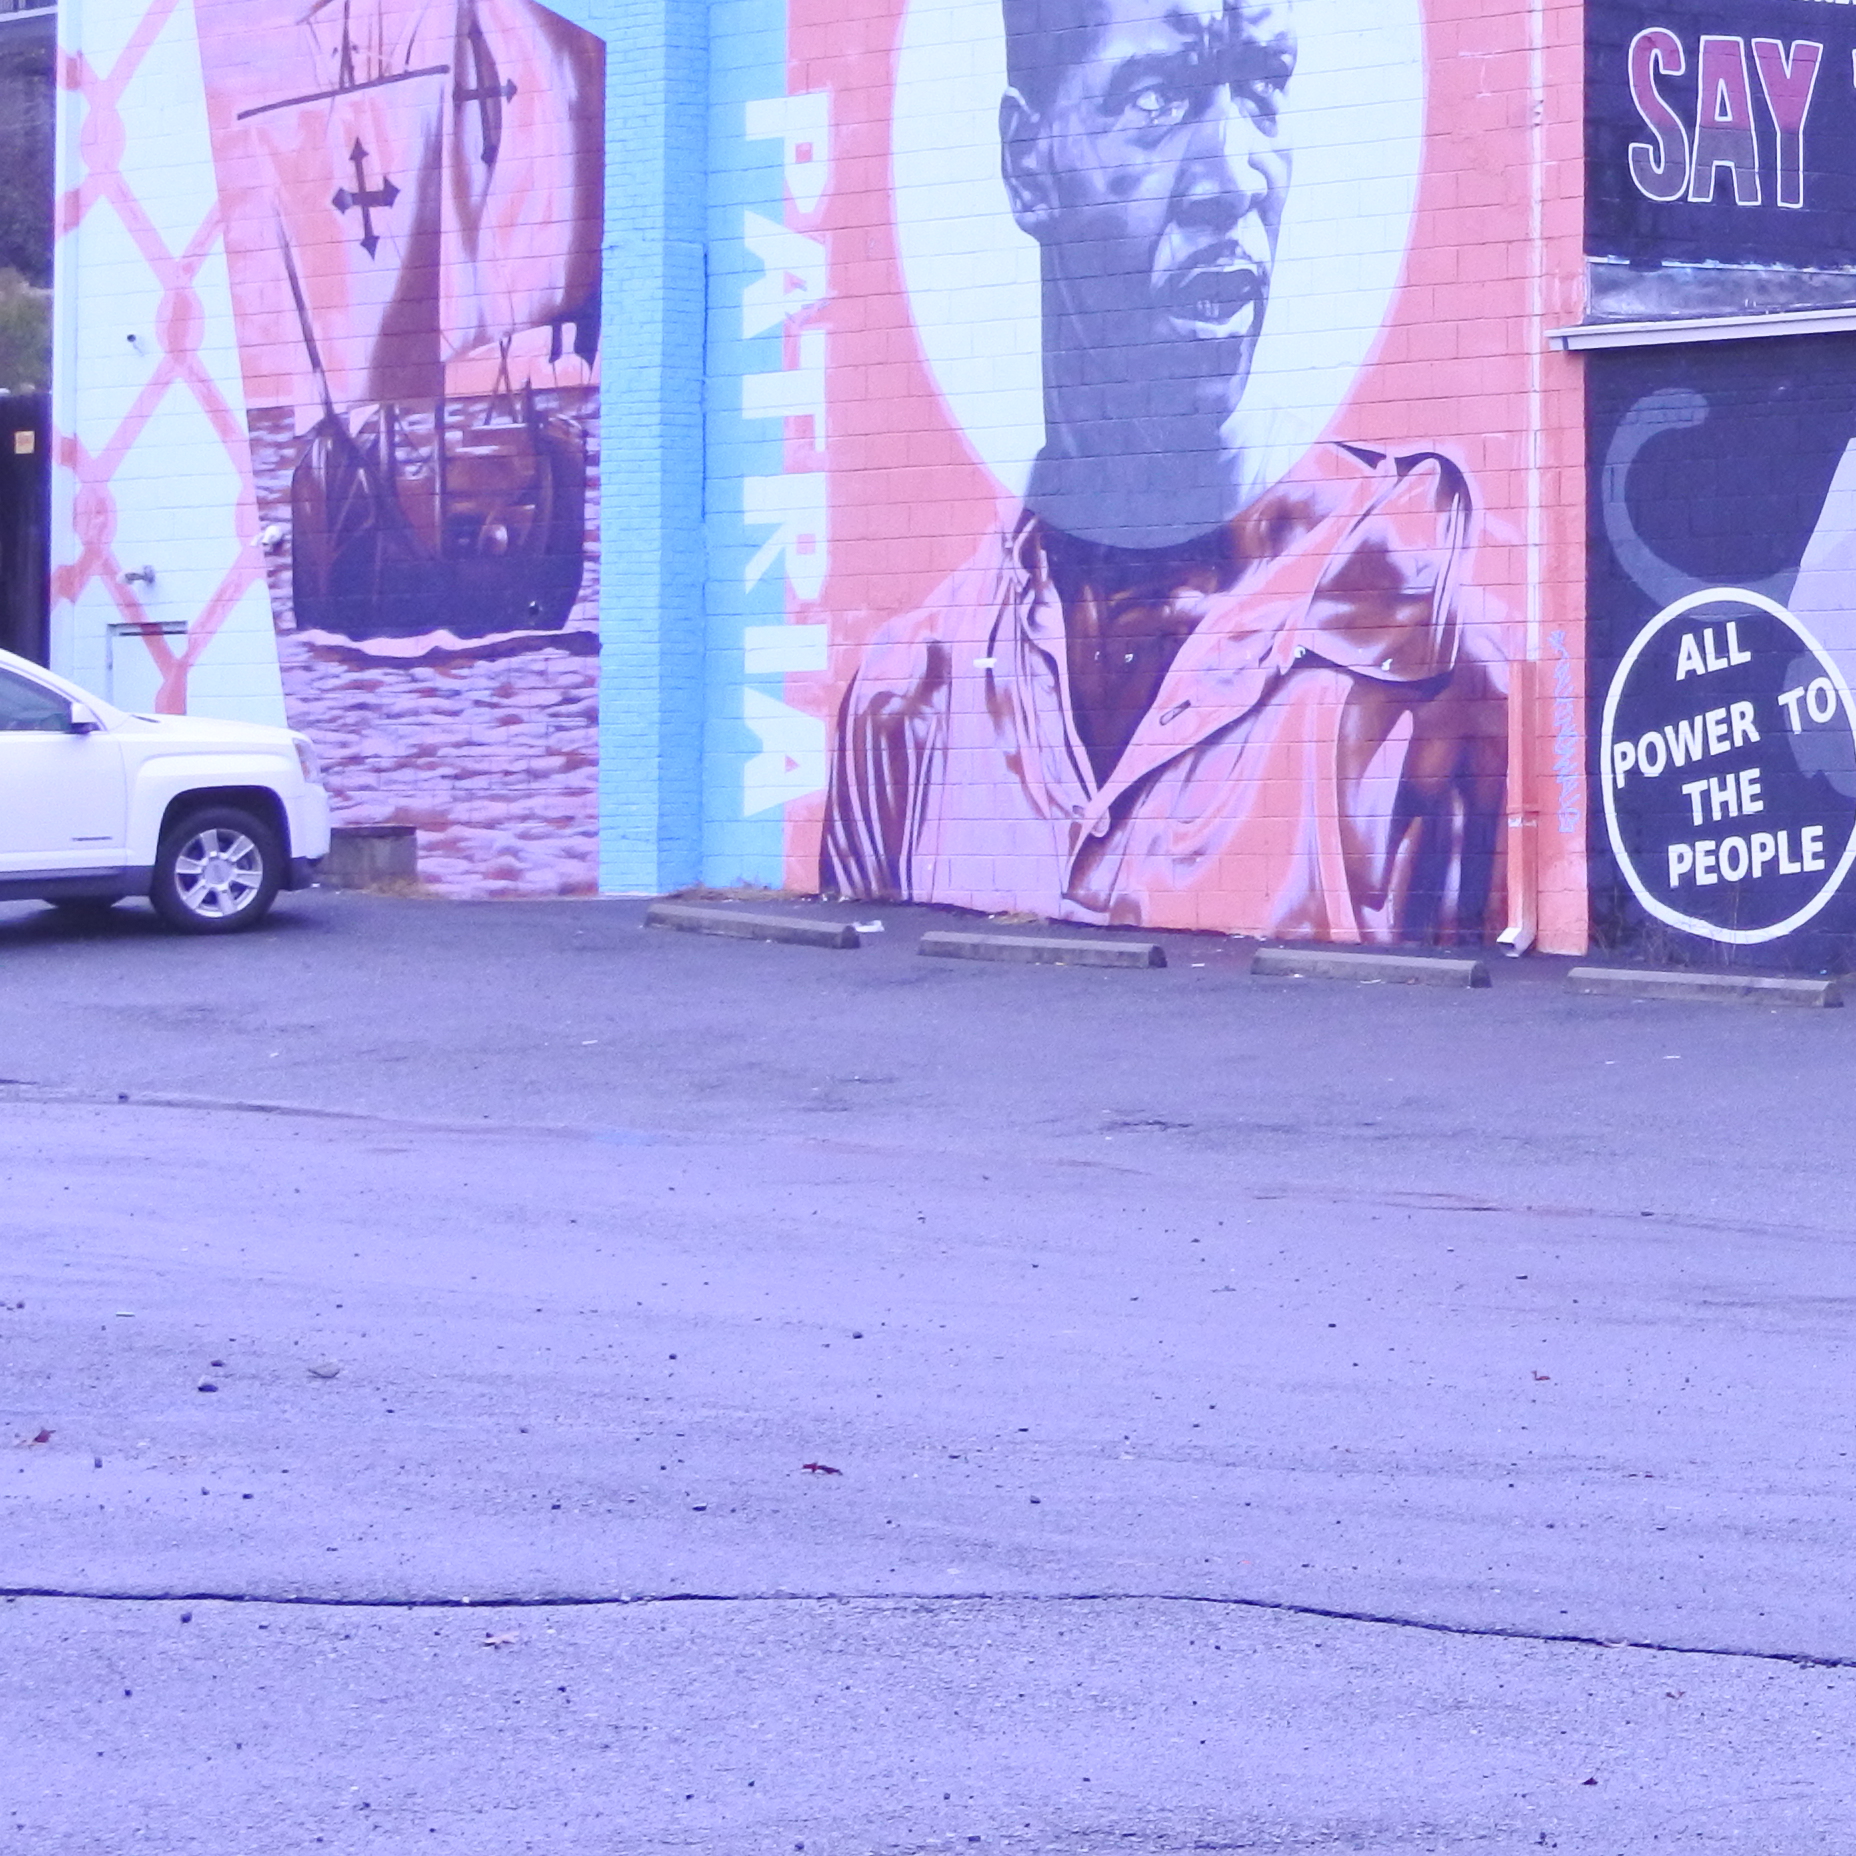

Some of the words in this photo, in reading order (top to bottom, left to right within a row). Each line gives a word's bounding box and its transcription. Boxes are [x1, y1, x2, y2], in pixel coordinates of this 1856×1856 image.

[1627, 27, 1824, 207] SAY
[740, 88, 836, 817] PATRIA
[1675, 622, 1753, 682] ALL
[1612, 698, 1760, 789] POWER
[1778, 675, 1838, 735] TO
[1682, 767, 1765, 827] THE
[1668, 824, 1826, 888] PEOPLE
